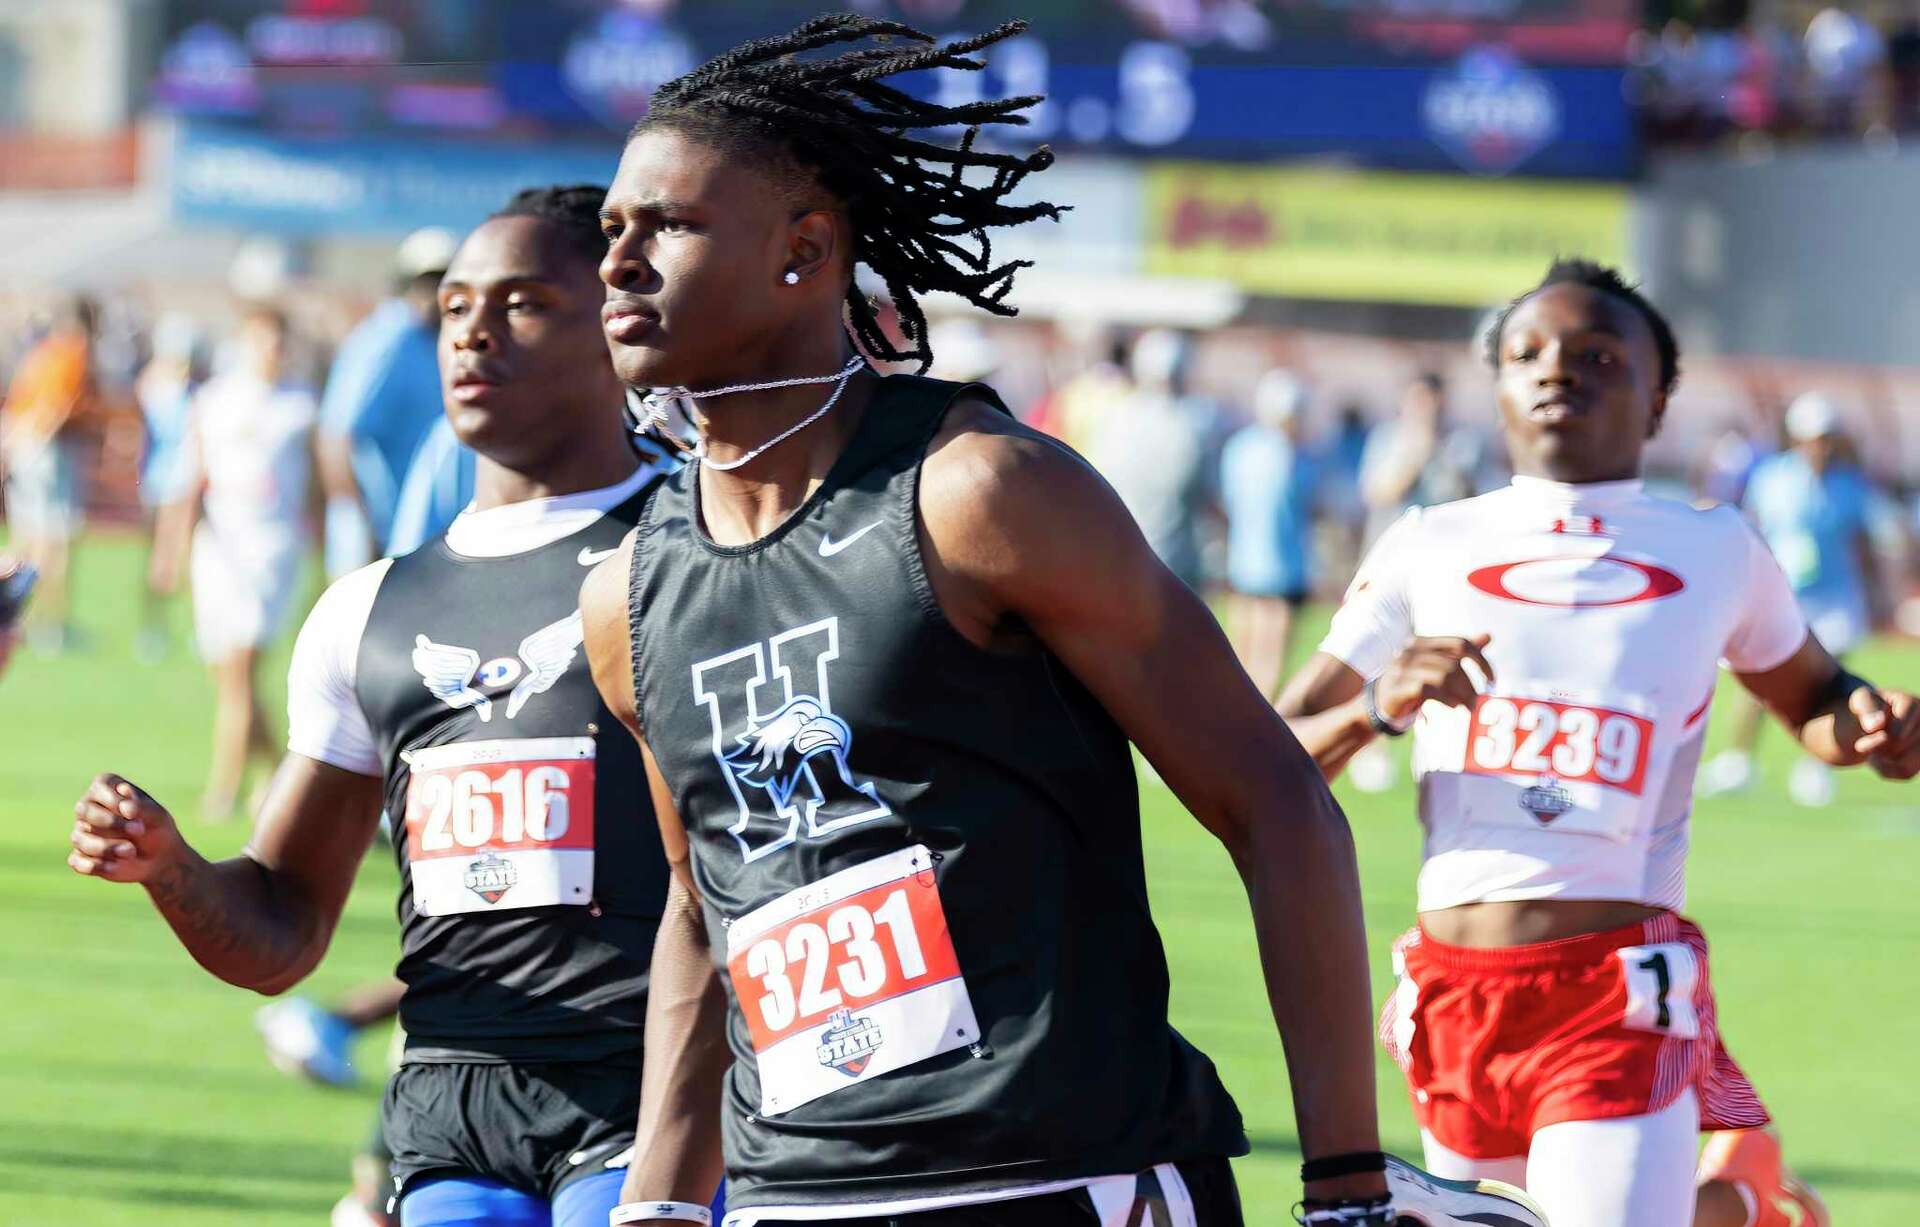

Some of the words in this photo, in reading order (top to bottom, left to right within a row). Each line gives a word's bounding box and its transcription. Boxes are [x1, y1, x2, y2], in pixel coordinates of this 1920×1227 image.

[1473, 698, 1642, 783] 3239
[420, 765, 571, 851] 2616
[746, 888, 928, 1032] 3231
[1638, 951, 1670, 1028] 1
[816, 1027, 883, 1066] STATE
